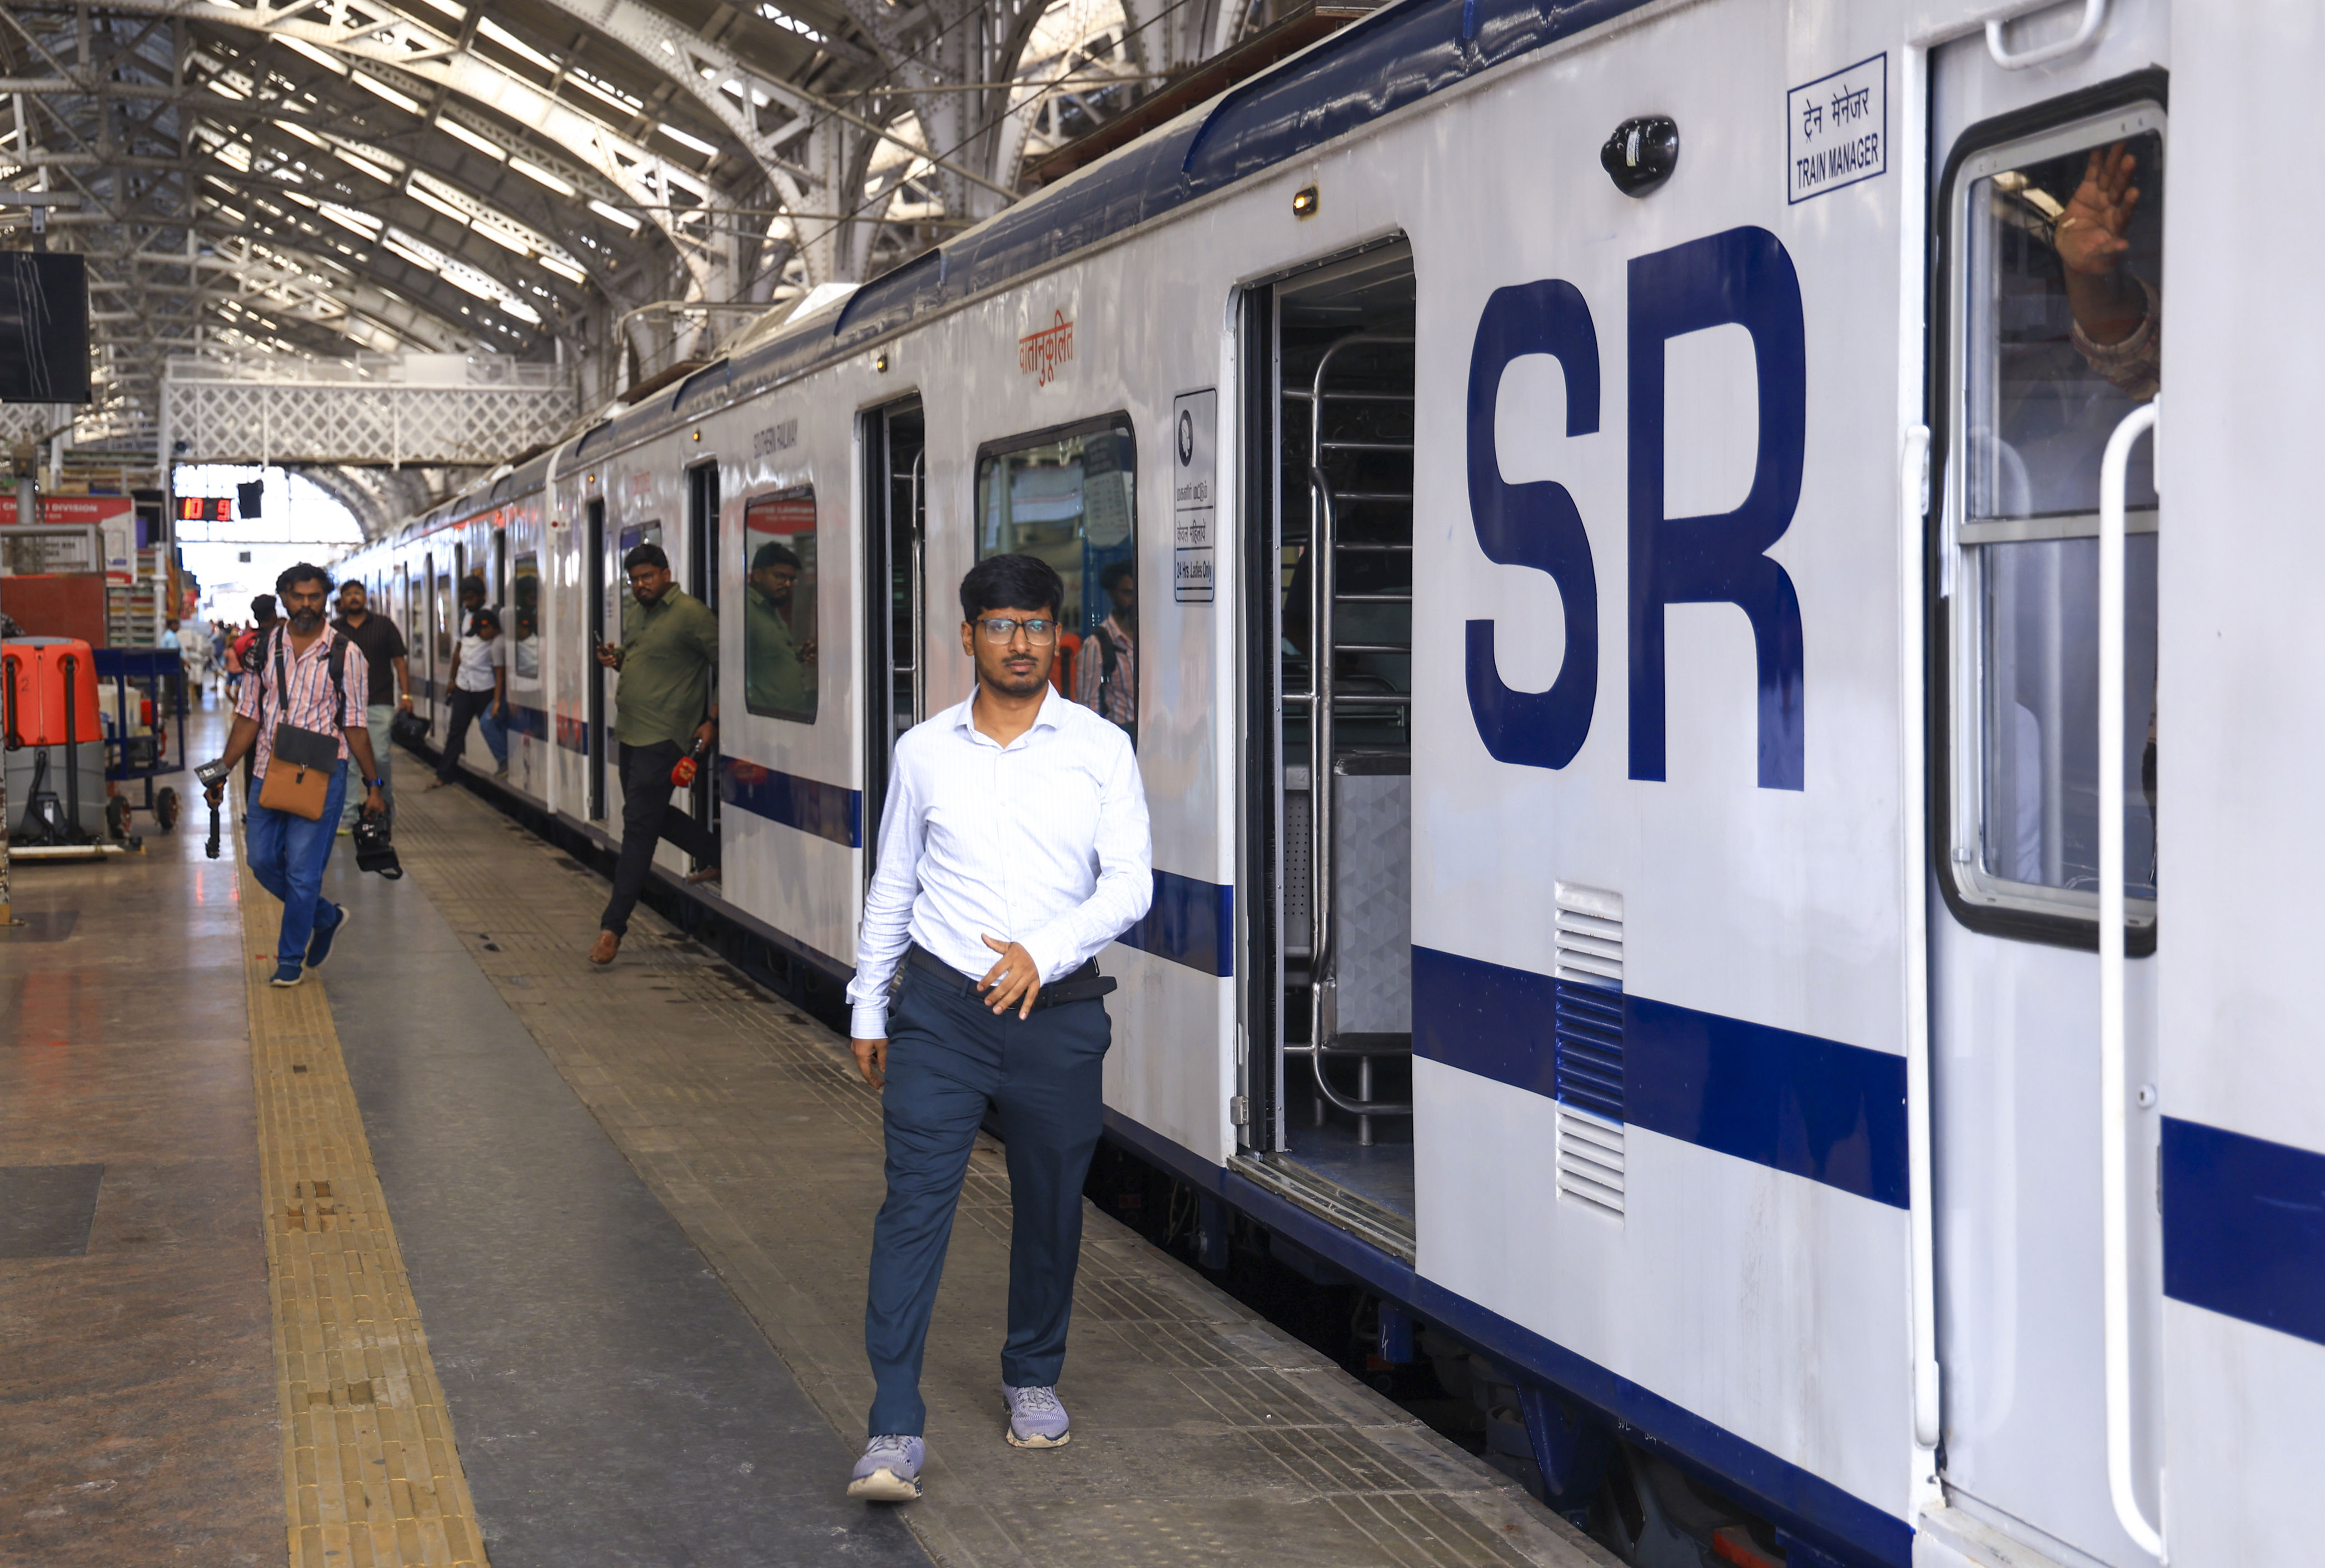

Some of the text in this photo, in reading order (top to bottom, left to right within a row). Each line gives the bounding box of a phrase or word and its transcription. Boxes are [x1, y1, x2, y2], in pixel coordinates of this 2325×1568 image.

[1803, 98, 1823, 143] ट्रेन
[1797, 133, 1878, 189] TRAIN MANAGER
[1019, 309, 1074, 387] वातानुकूलित
[52, 502, 98, 512] DIVISION
[1465, 226, 1806, 792] SR
[1177, 520, 1188, 542] केवल
[1177, 561, 1182, 579] 24
[1203, 560, 1212, 583] Only
[21, 676, 29, 692] 2
